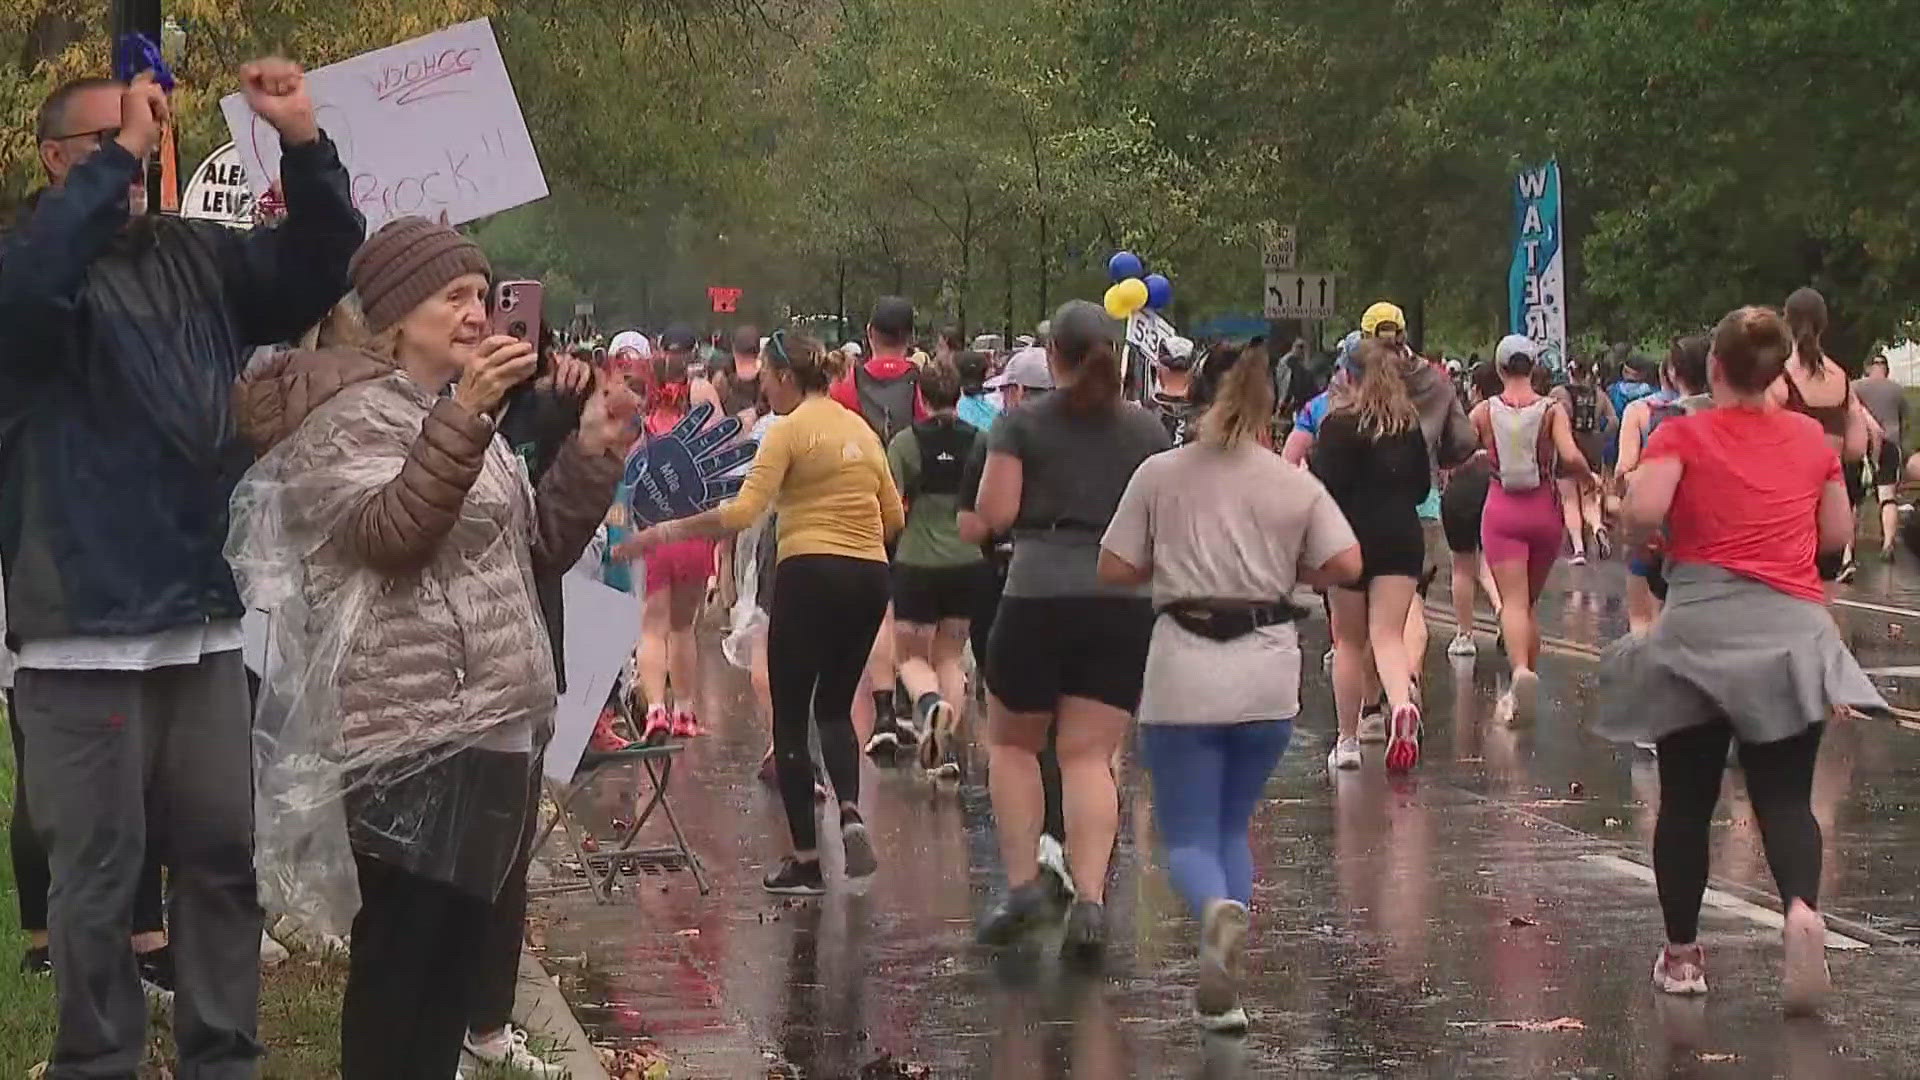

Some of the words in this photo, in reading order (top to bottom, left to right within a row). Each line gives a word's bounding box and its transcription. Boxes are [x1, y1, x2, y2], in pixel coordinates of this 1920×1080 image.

[203, 162, 247, 186] ALE
[1172, 418, 1185, 449] NA
[636, 458, 676, 516] Campion
